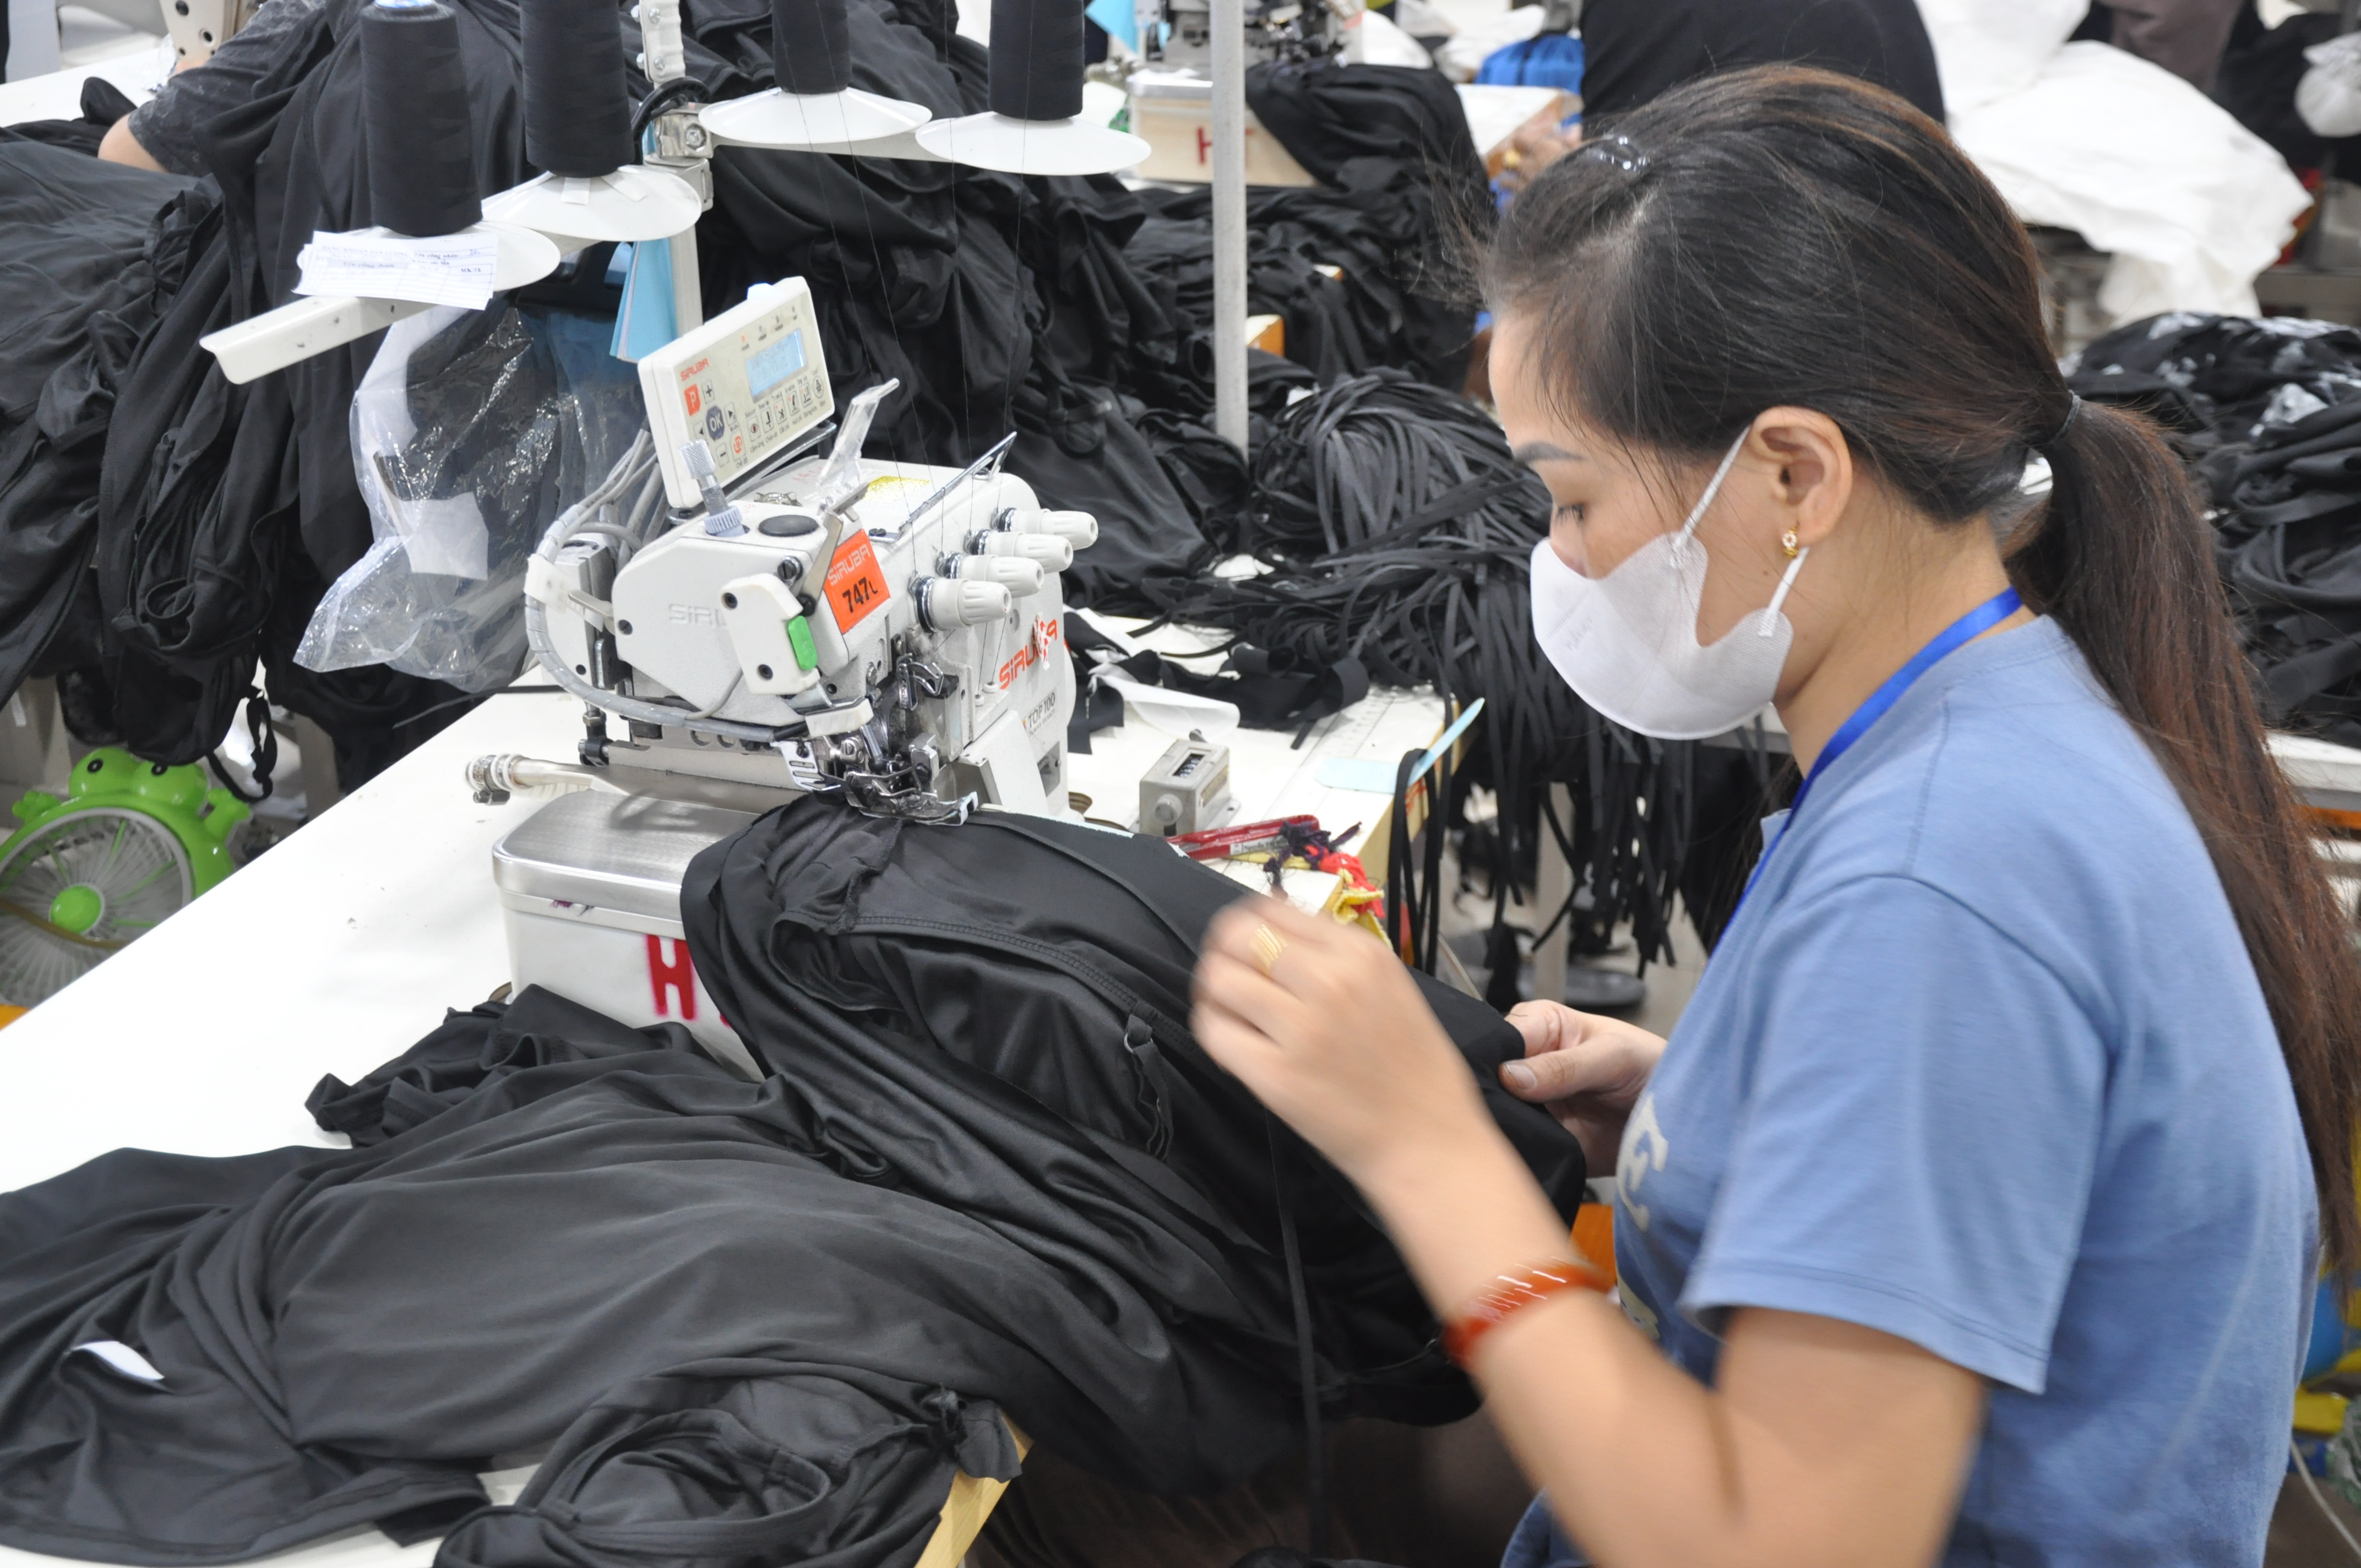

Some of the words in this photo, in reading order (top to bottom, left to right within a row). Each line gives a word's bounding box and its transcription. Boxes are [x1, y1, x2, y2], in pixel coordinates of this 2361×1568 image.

[689, 391, 697, 410] P
[709, 413, 723, 432] OK
[1028, 704, 1043, 728] TOP
[1043, 692, 1056, 714] 100
